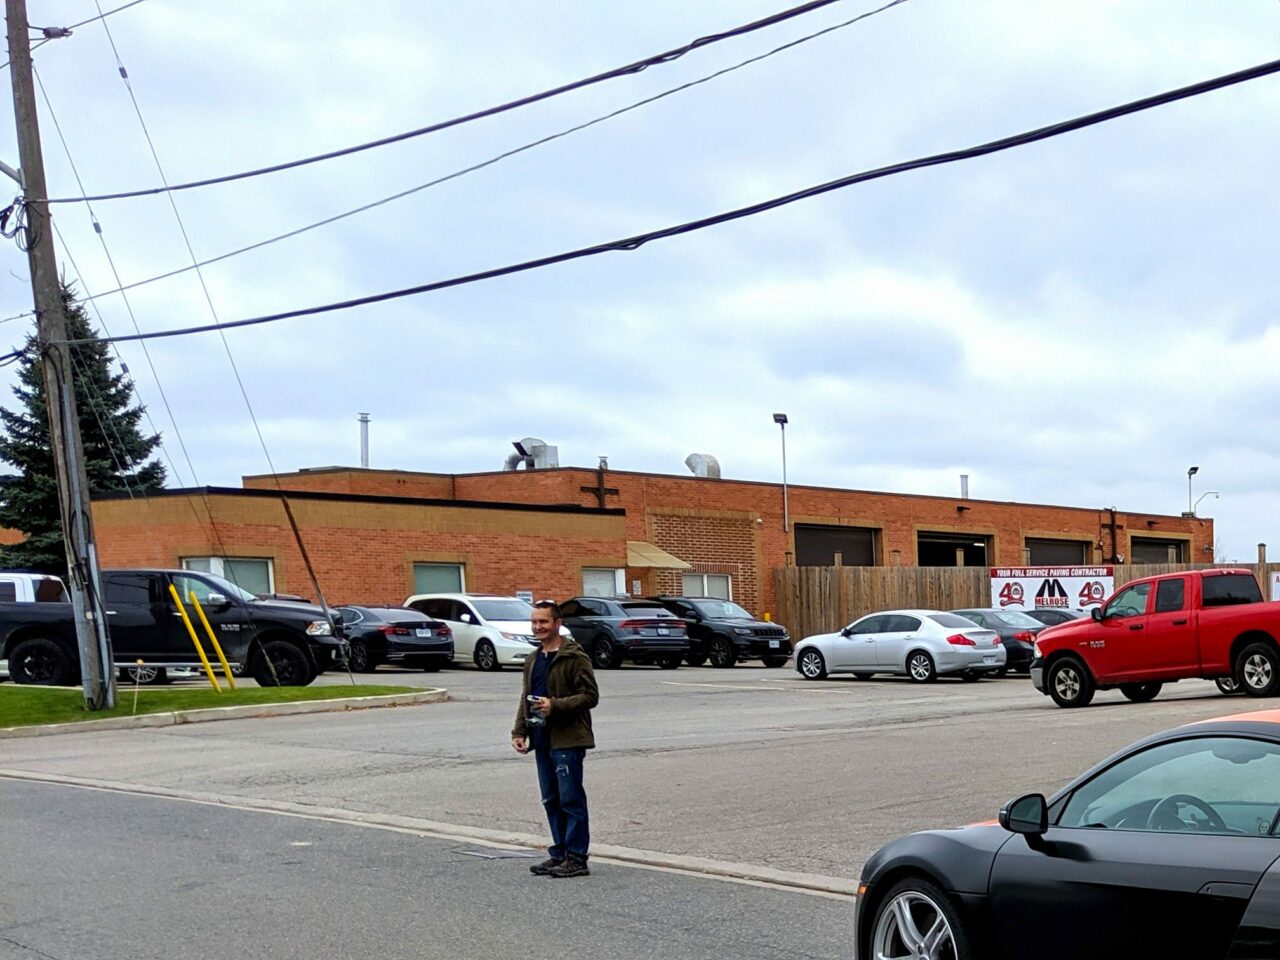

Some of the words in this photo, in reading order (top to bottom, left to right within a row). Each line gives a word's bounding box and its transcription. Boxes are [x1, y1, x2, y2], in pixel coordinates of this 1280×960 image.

[997, 569, 1011, 577] YOUR
[1012, 569, 1025, 577] FULL
[1026, 569, 1048, 577] SERVICE
[1049, 569, 1070, 577] PAVING
[1071, 568, 1107, 576] CONTRACTOR
[1035, 597, 1069, 606] MELROSE
